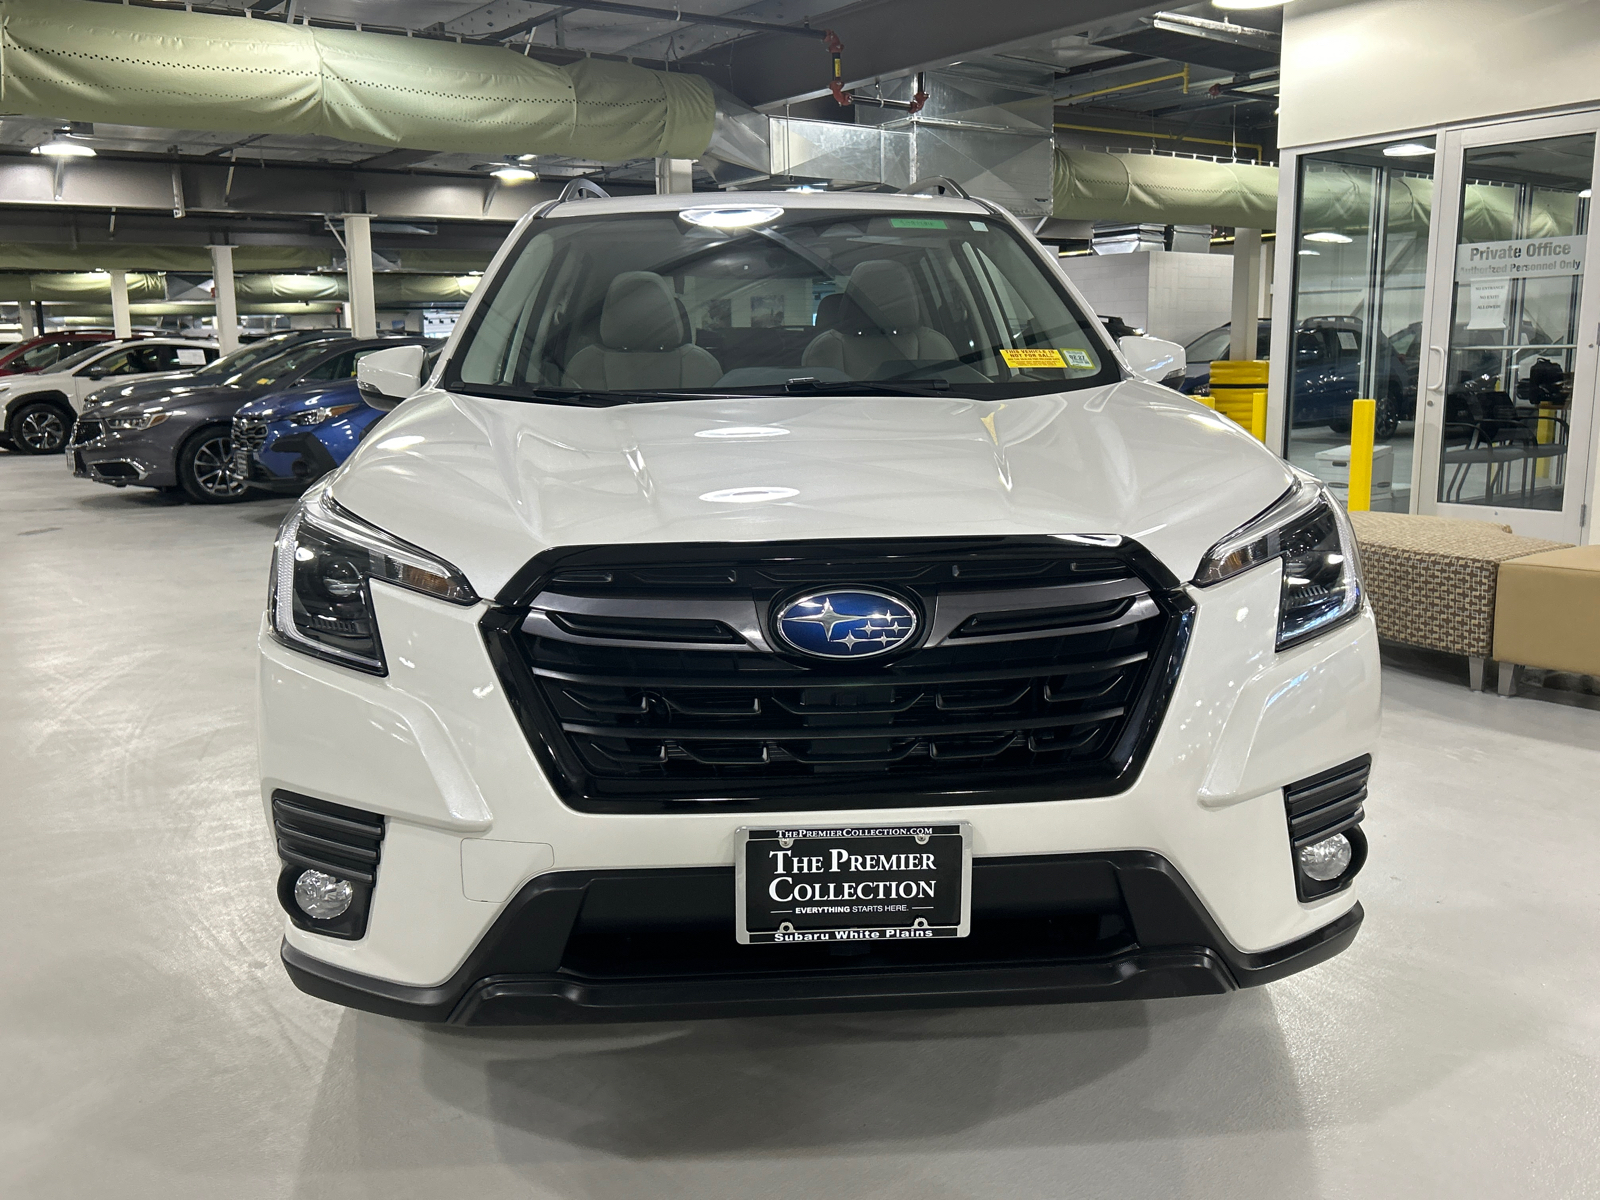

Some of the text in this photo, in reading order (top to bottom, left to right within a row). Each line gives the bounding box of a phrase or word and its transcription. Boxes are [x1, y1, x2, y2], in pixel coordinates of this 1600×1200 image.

[1470, 241, 1571, 261] Private Office
[1510, 261, 1557, 272] Personnel
[1559, 259, 1581, 271] Only
[768, 876, 937, 902] COLLECTION
[795, 904, 909, 914] EVERYTHING STARTS HERE.
[774, 928, 933, 942] Subaru White Plains
